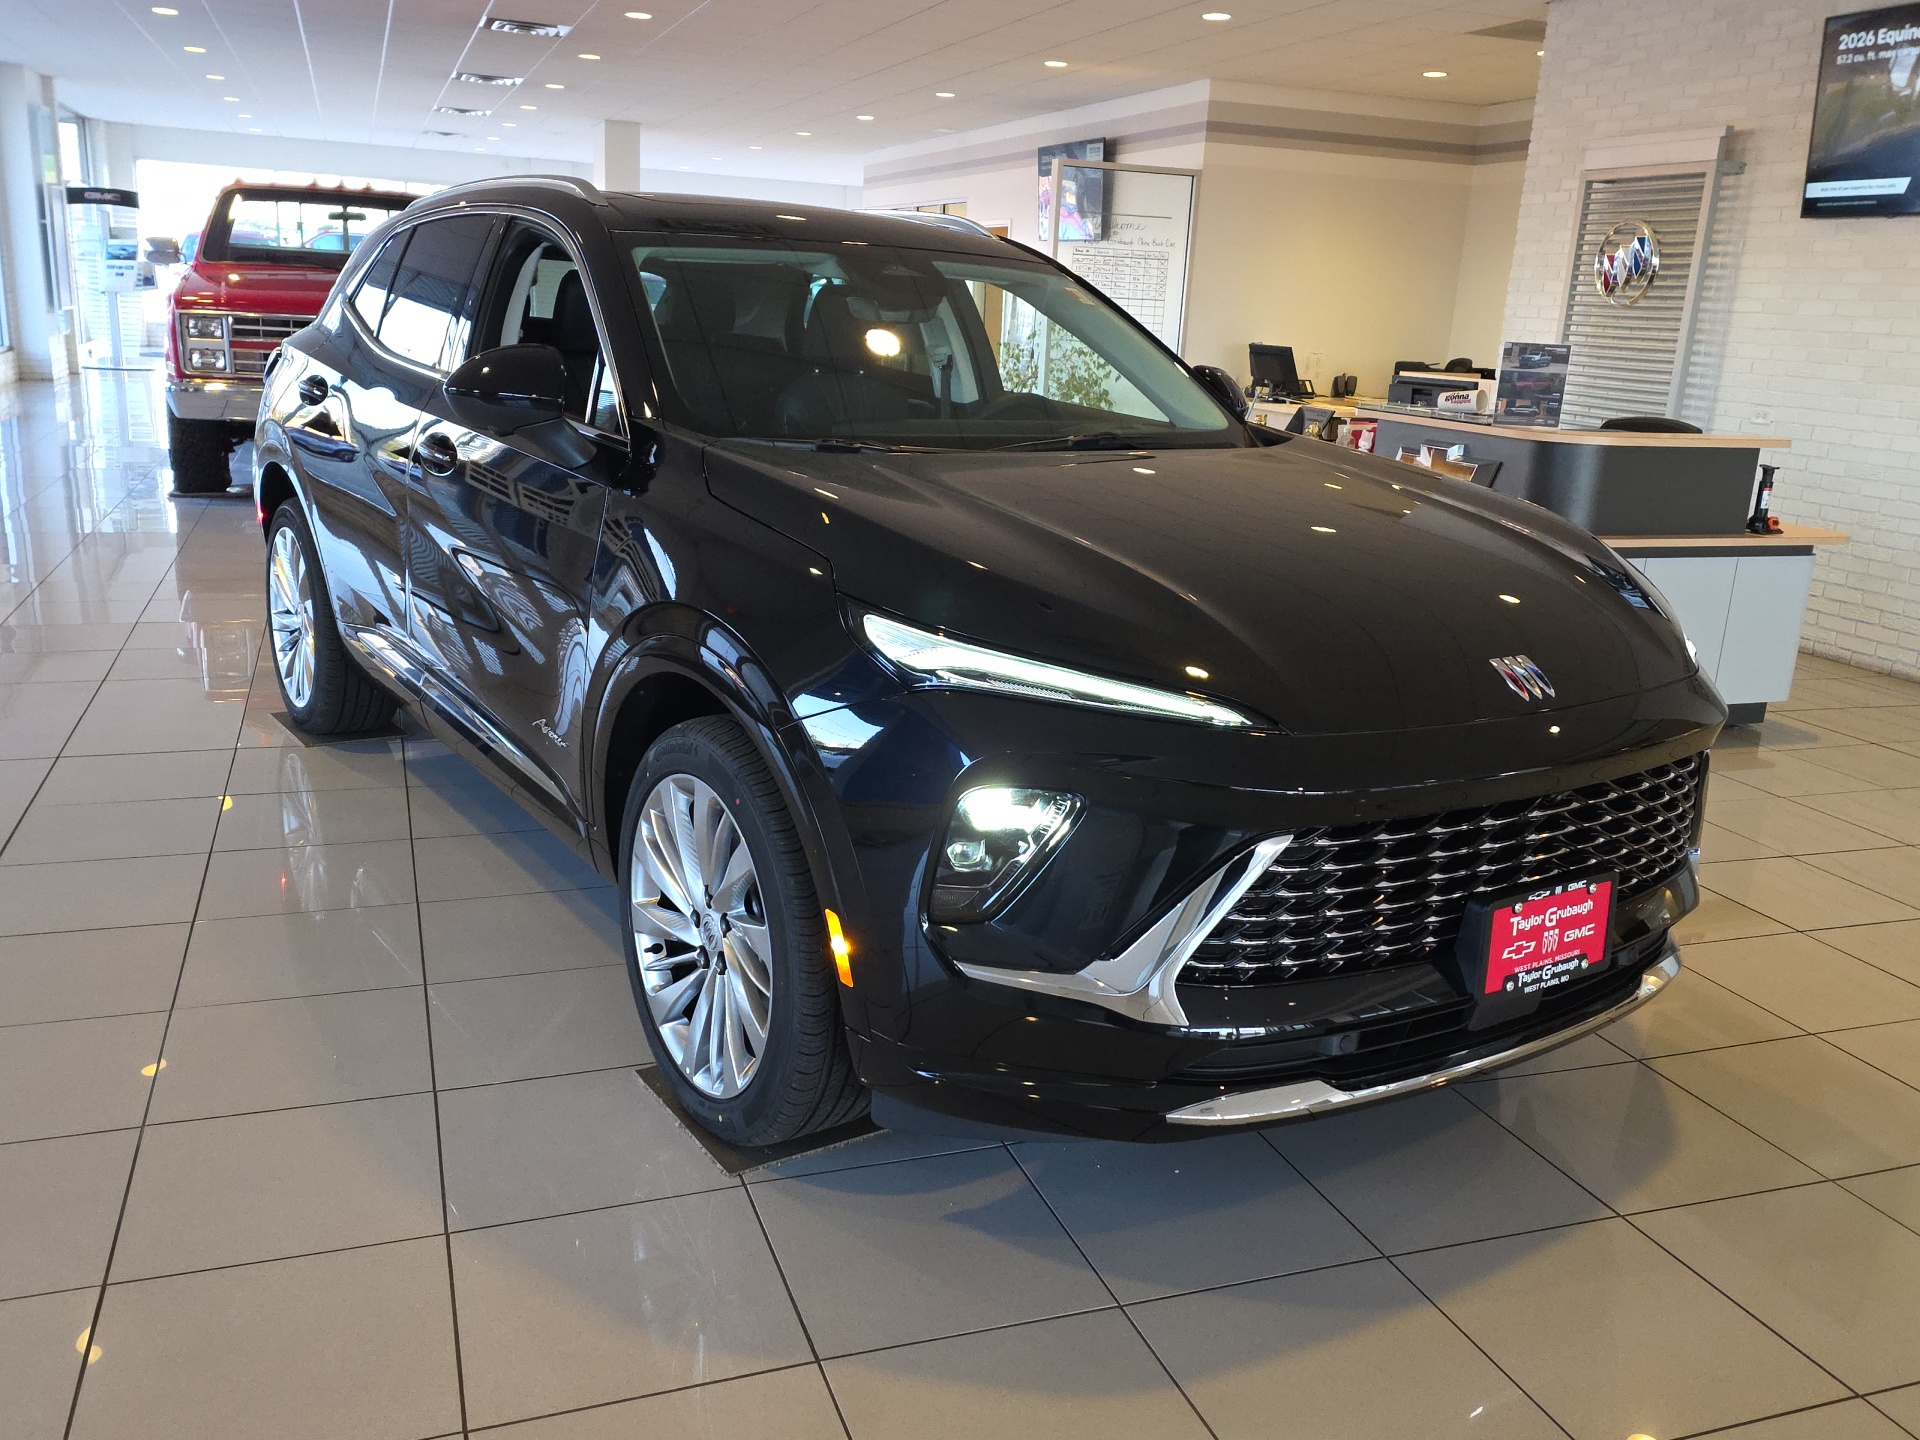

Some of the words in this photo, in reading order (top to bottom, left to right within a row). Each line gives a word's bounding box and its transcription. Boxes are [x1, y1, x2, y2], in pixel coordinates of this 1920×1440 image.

[1838, 30, 1875, 50] 2026
[84, 191, 120, 201] GMC
[531, 718, 569, 748] Avenir
[1567, 880, 1587, 891] GMC
[1510, 914, 1544, 936] Taylor
[1545, 899, 1594, 927] Grubaugh
[1564, 923, 1595, 942] GMC
[1514, 962, 1531, 973] WEST
[1555, 949, 1581, 962] MISSOURI
[1517, 970, 1542, 987] Taylor
[1542, 957, 1579, 980] Grubaugh
[1524, 983, 1540, 994] WEST
[1560, 974, 1570, 983] MO
